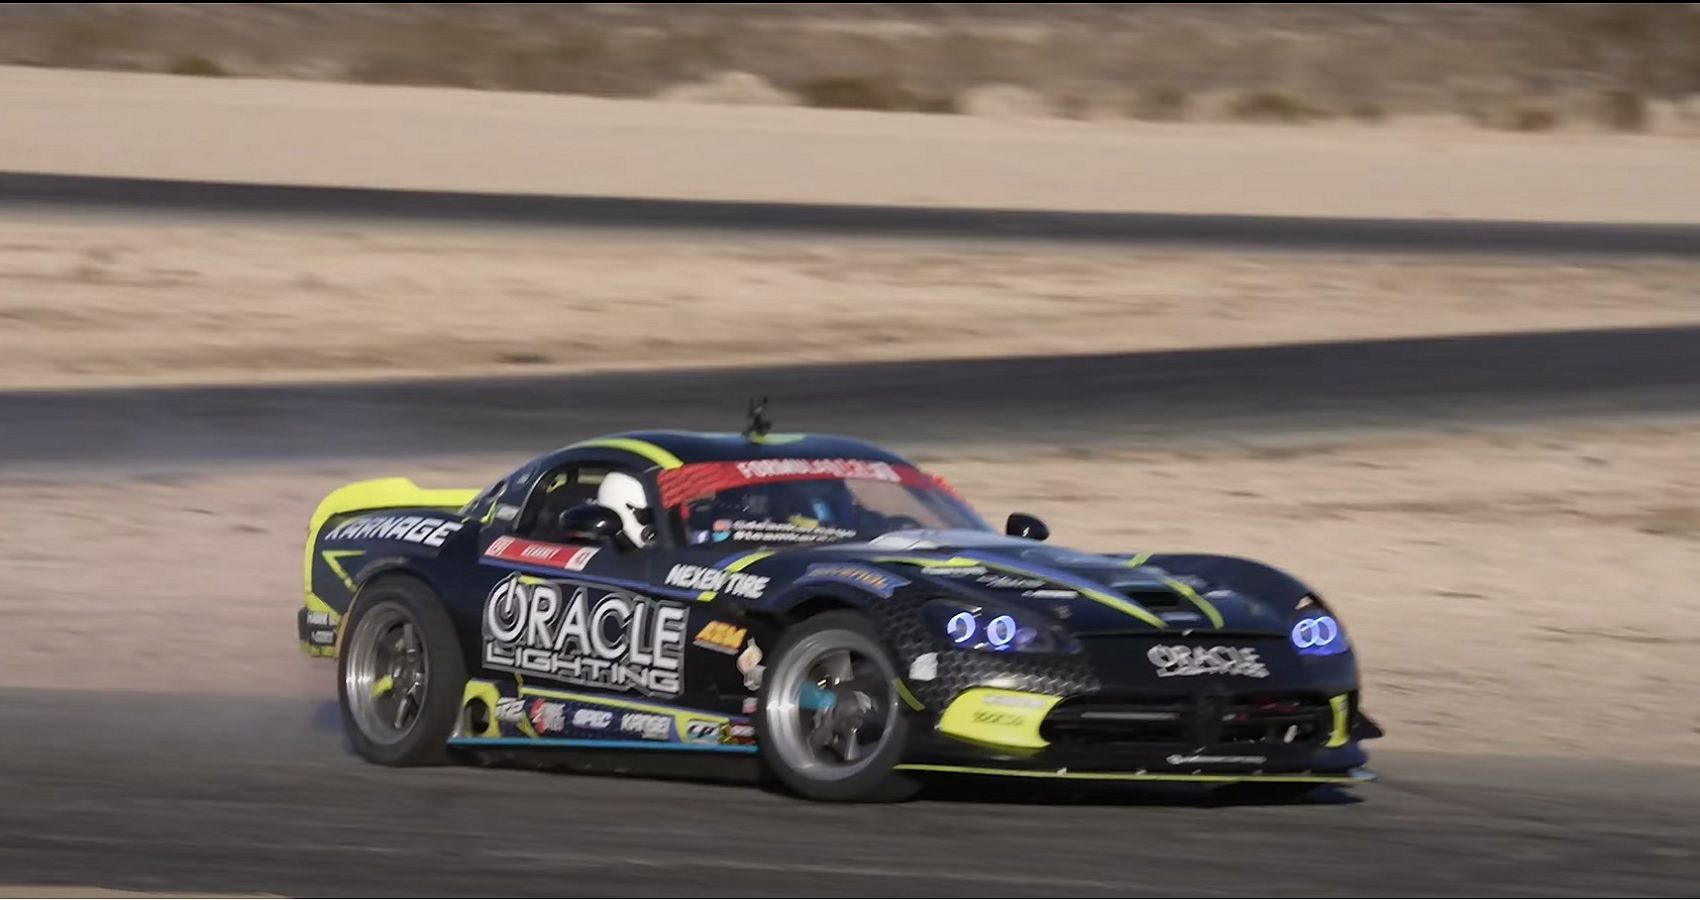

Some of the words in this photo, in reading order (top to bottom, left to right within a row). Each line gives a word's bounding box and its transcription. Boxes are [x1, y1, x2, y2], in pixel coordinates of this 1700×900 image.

[324, 515, 463, 548] KARNAGE
[664, 563, 729, 592] NEXEN
[724, 571, 771, 600] TIRE
[486, 575, 686, 670] ORACLE
[486, 642, 681, 695] LIGHTING
